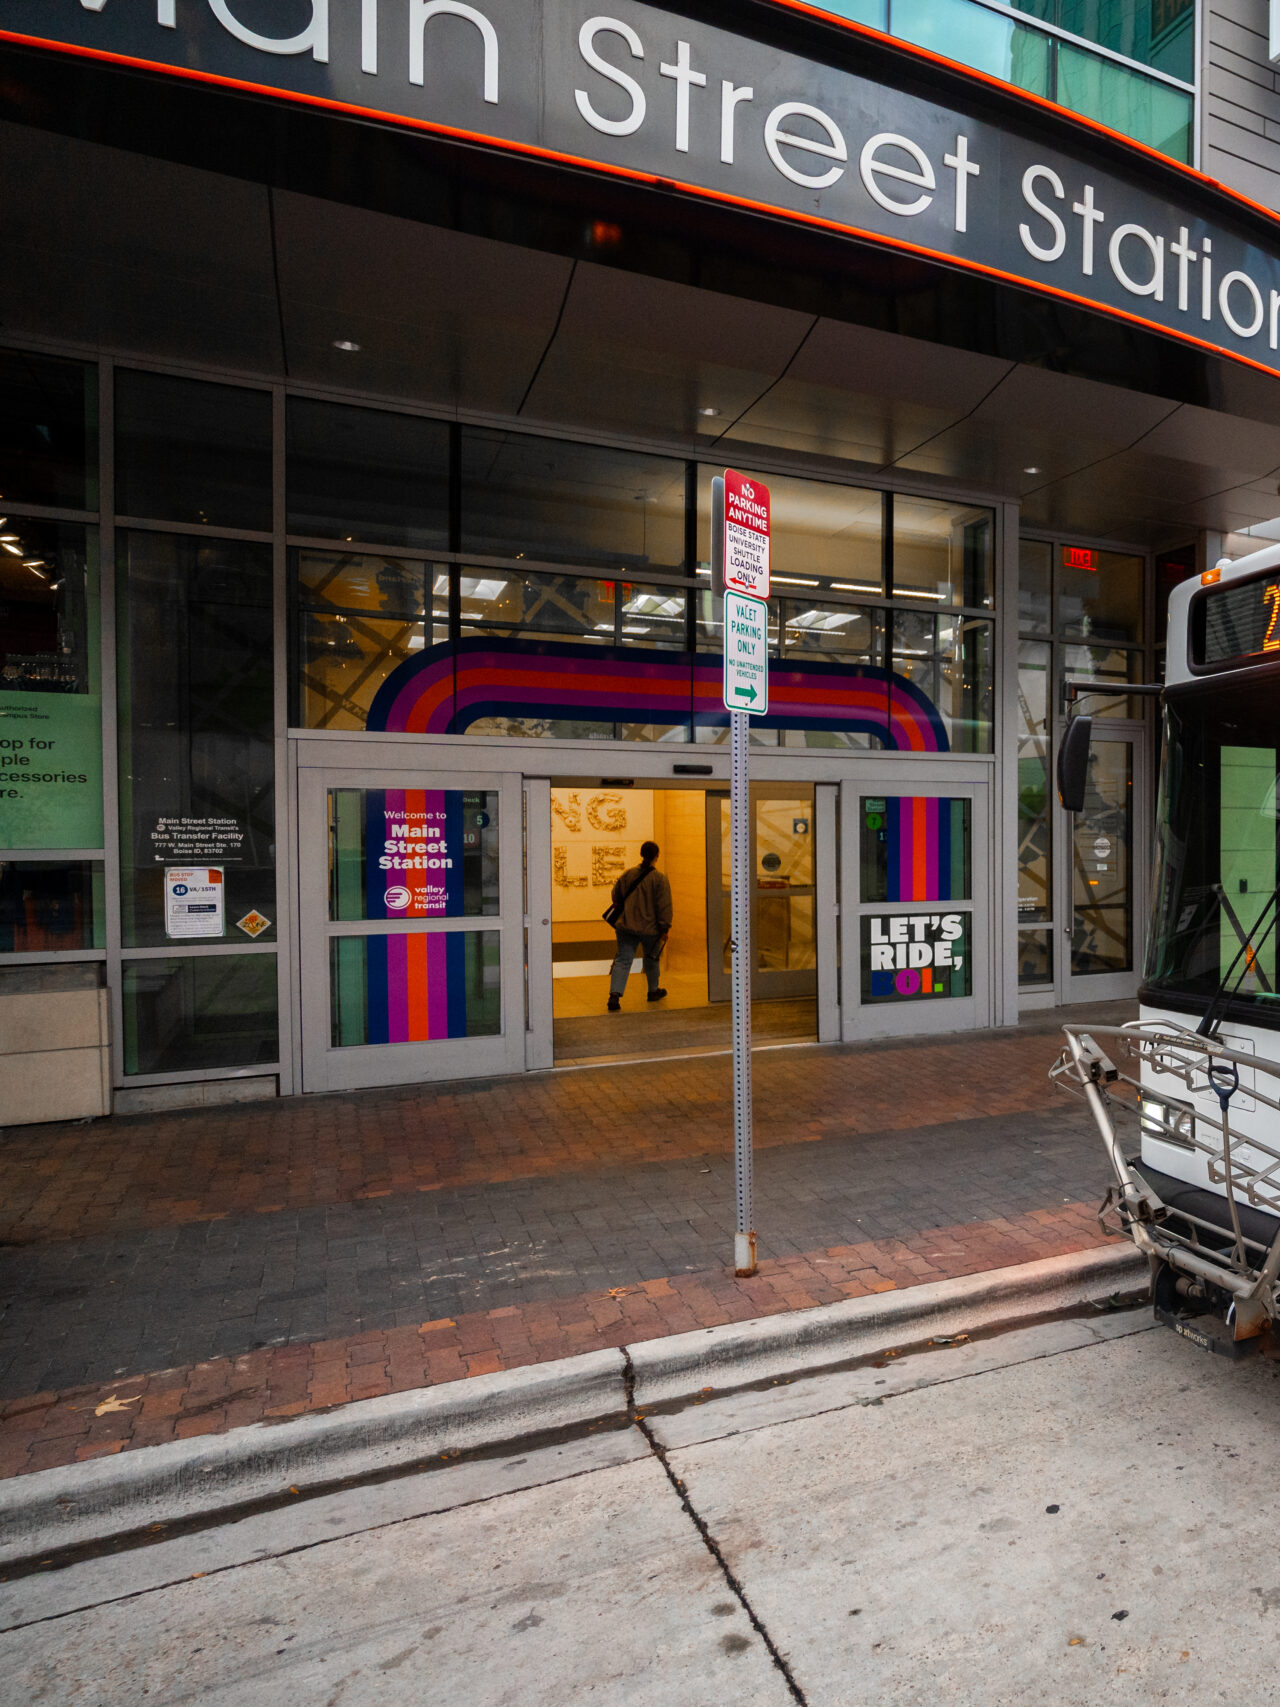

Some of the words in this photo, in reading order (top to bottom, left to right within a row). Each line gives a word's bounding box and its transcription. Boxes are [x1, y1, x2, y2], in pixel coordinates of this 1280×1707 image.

[574, 16, 980, 233] Street
[741, 484, 755, 499] NO
[729, 492, 767, 517] PARKING
[728, 506, 767, 531] ANYTIME
[728, 523, 747, 537] BOISE
[748, 531, 767, 545] STATE
[729, 534, 765, 554] UNIVERSITY
[733, 547, 760, 563] SHUTTLE
[730, 556, 764, 575] LOADING
[737, 571, 756, 584] ONLY
[736, 604, 757, 622] VALET
[731, 621, 762, 640] PARKING
[737, 640, 756, 655] ONLY
[737, 661, 763, 672] UNATTENDED
[736, 670, 757, 680] VEHICLES
[0, 739, 24, 751] op
[29, 738, 56, 750] for
[1, 754, 30, 767] ple
[0, 770, 87, 783] cessories
[384, 811, 434, 819] Welcome
[391, 824, 440, 838] Main
[384, 840, 448, 853] Street
[378, 856, 453, 870] Station
[414, 885, 445, 894] valley
[414, 893, 449, 903] regional
[870, 914, 963, 943] LET'S
[870, 941, 963, 971] RIDE,
[871, 967, 943, 997] BOI.
